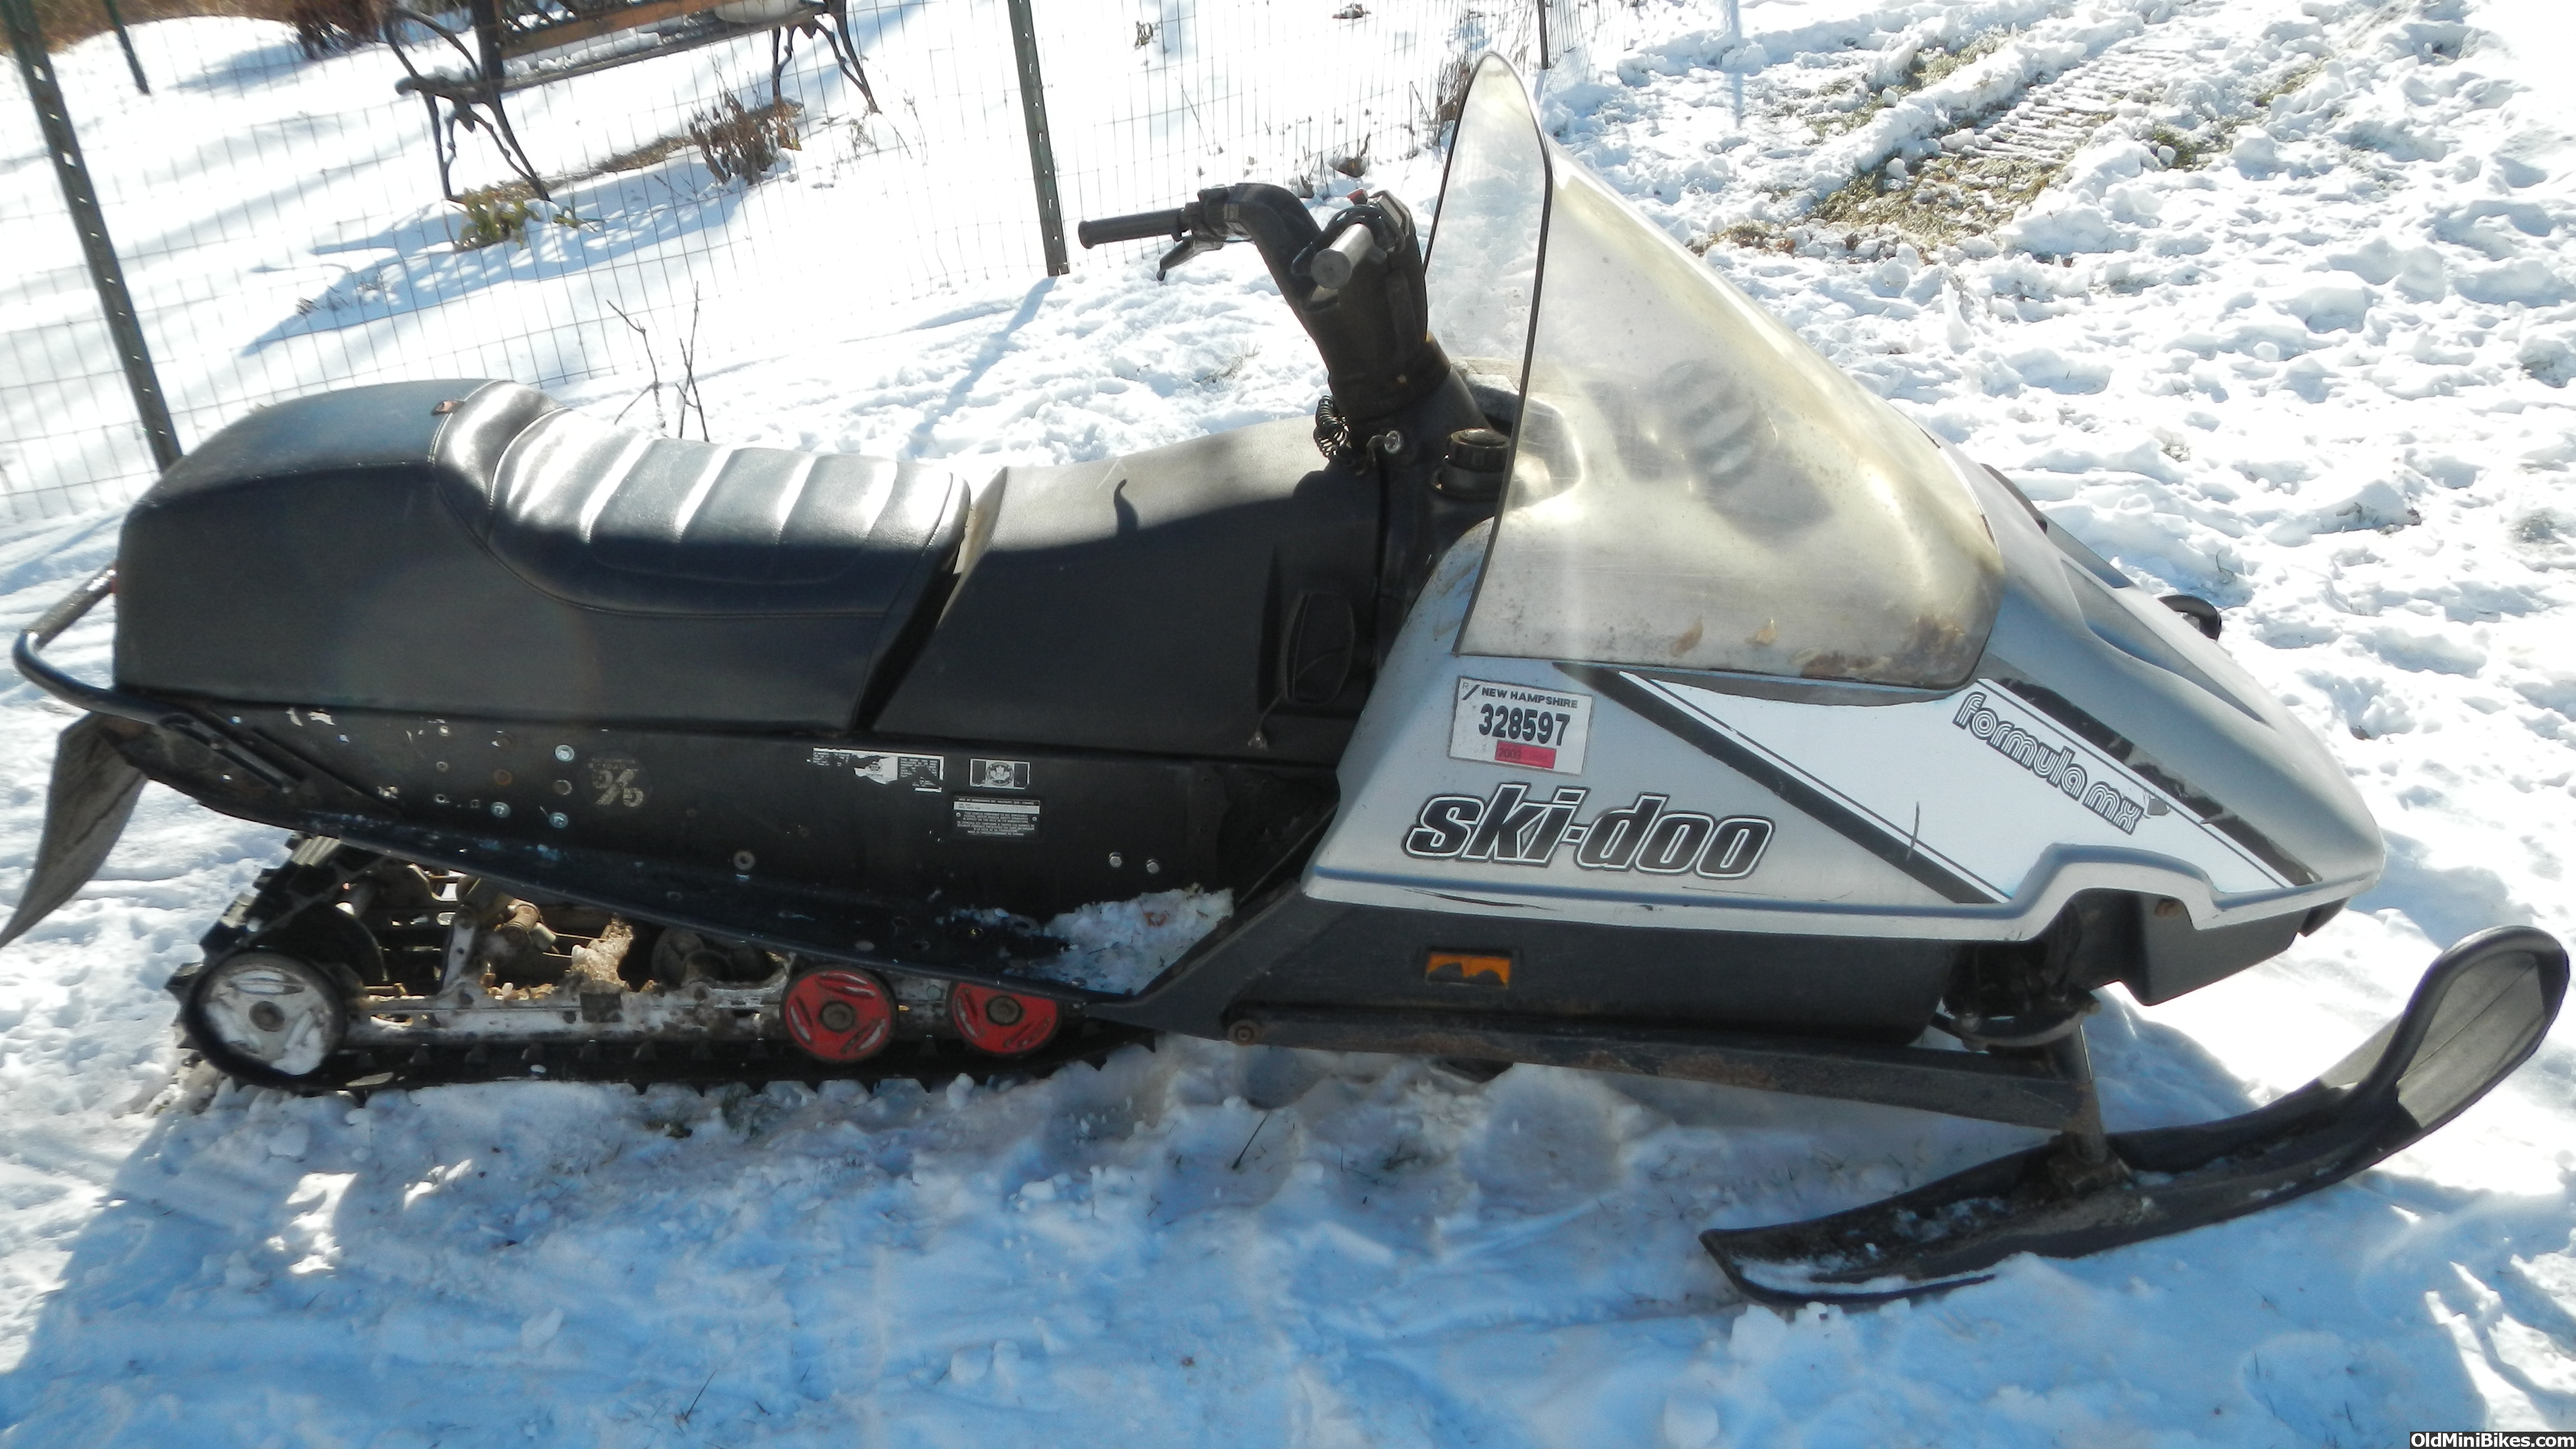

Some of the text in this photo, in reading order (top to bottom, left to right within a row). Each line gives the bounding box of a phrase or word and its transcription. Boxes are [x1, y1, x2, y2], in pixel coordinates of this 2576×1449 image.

[1481, 687, 1578, 708] NEW HAMPSHIRE
[1479, 703, 1570, 746] 328597
[1401, 782, 1775, 880] ski-doo
